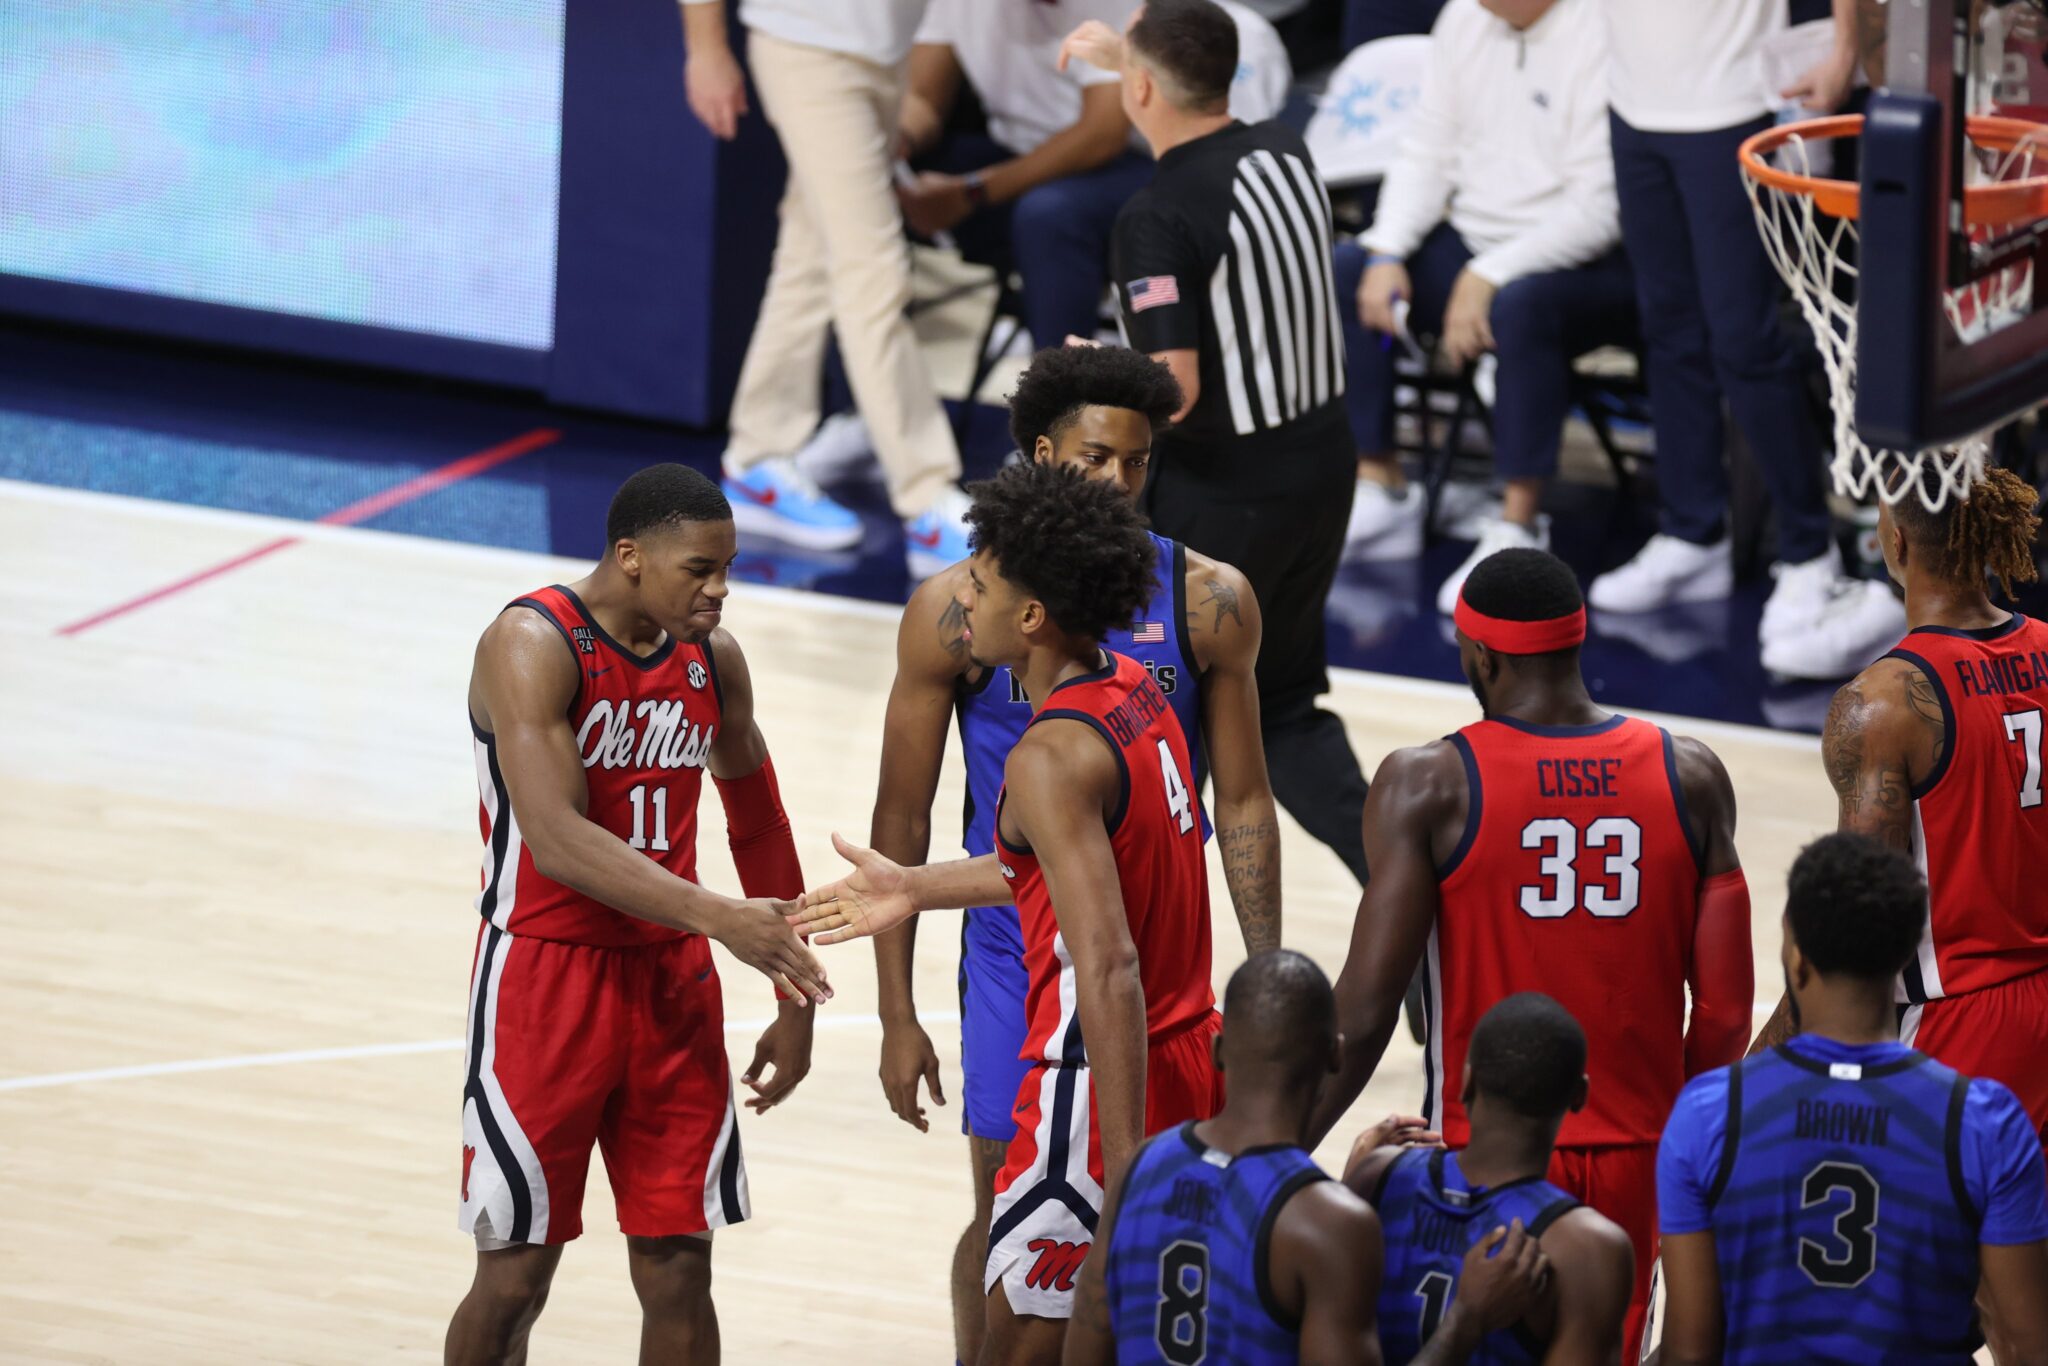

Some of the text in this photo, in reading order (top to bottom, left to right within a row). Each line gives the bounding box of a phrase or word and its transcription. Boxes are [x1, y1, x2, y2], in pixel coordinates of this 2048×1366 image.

[572, 628, 595, 640] BALL
[580, 640, 593, 652] 24
[1954, 650, 2048, 697] FLANIGA
[577, 699, 714, 770] Ole Miss
[2002, 708, 2043, 810] 7
[628, 784, 670, 852] 11
[1157, 737, 1195, 838] 4
[1519, 816, 1643, 920] 33
[1796, 1099, 1891, 1147] BROWN
[1797, 1160, 1880, 1288] 3
[1025, 1238, 1091, 1291] M
[1154, 1239, 1210, 1366] 8
